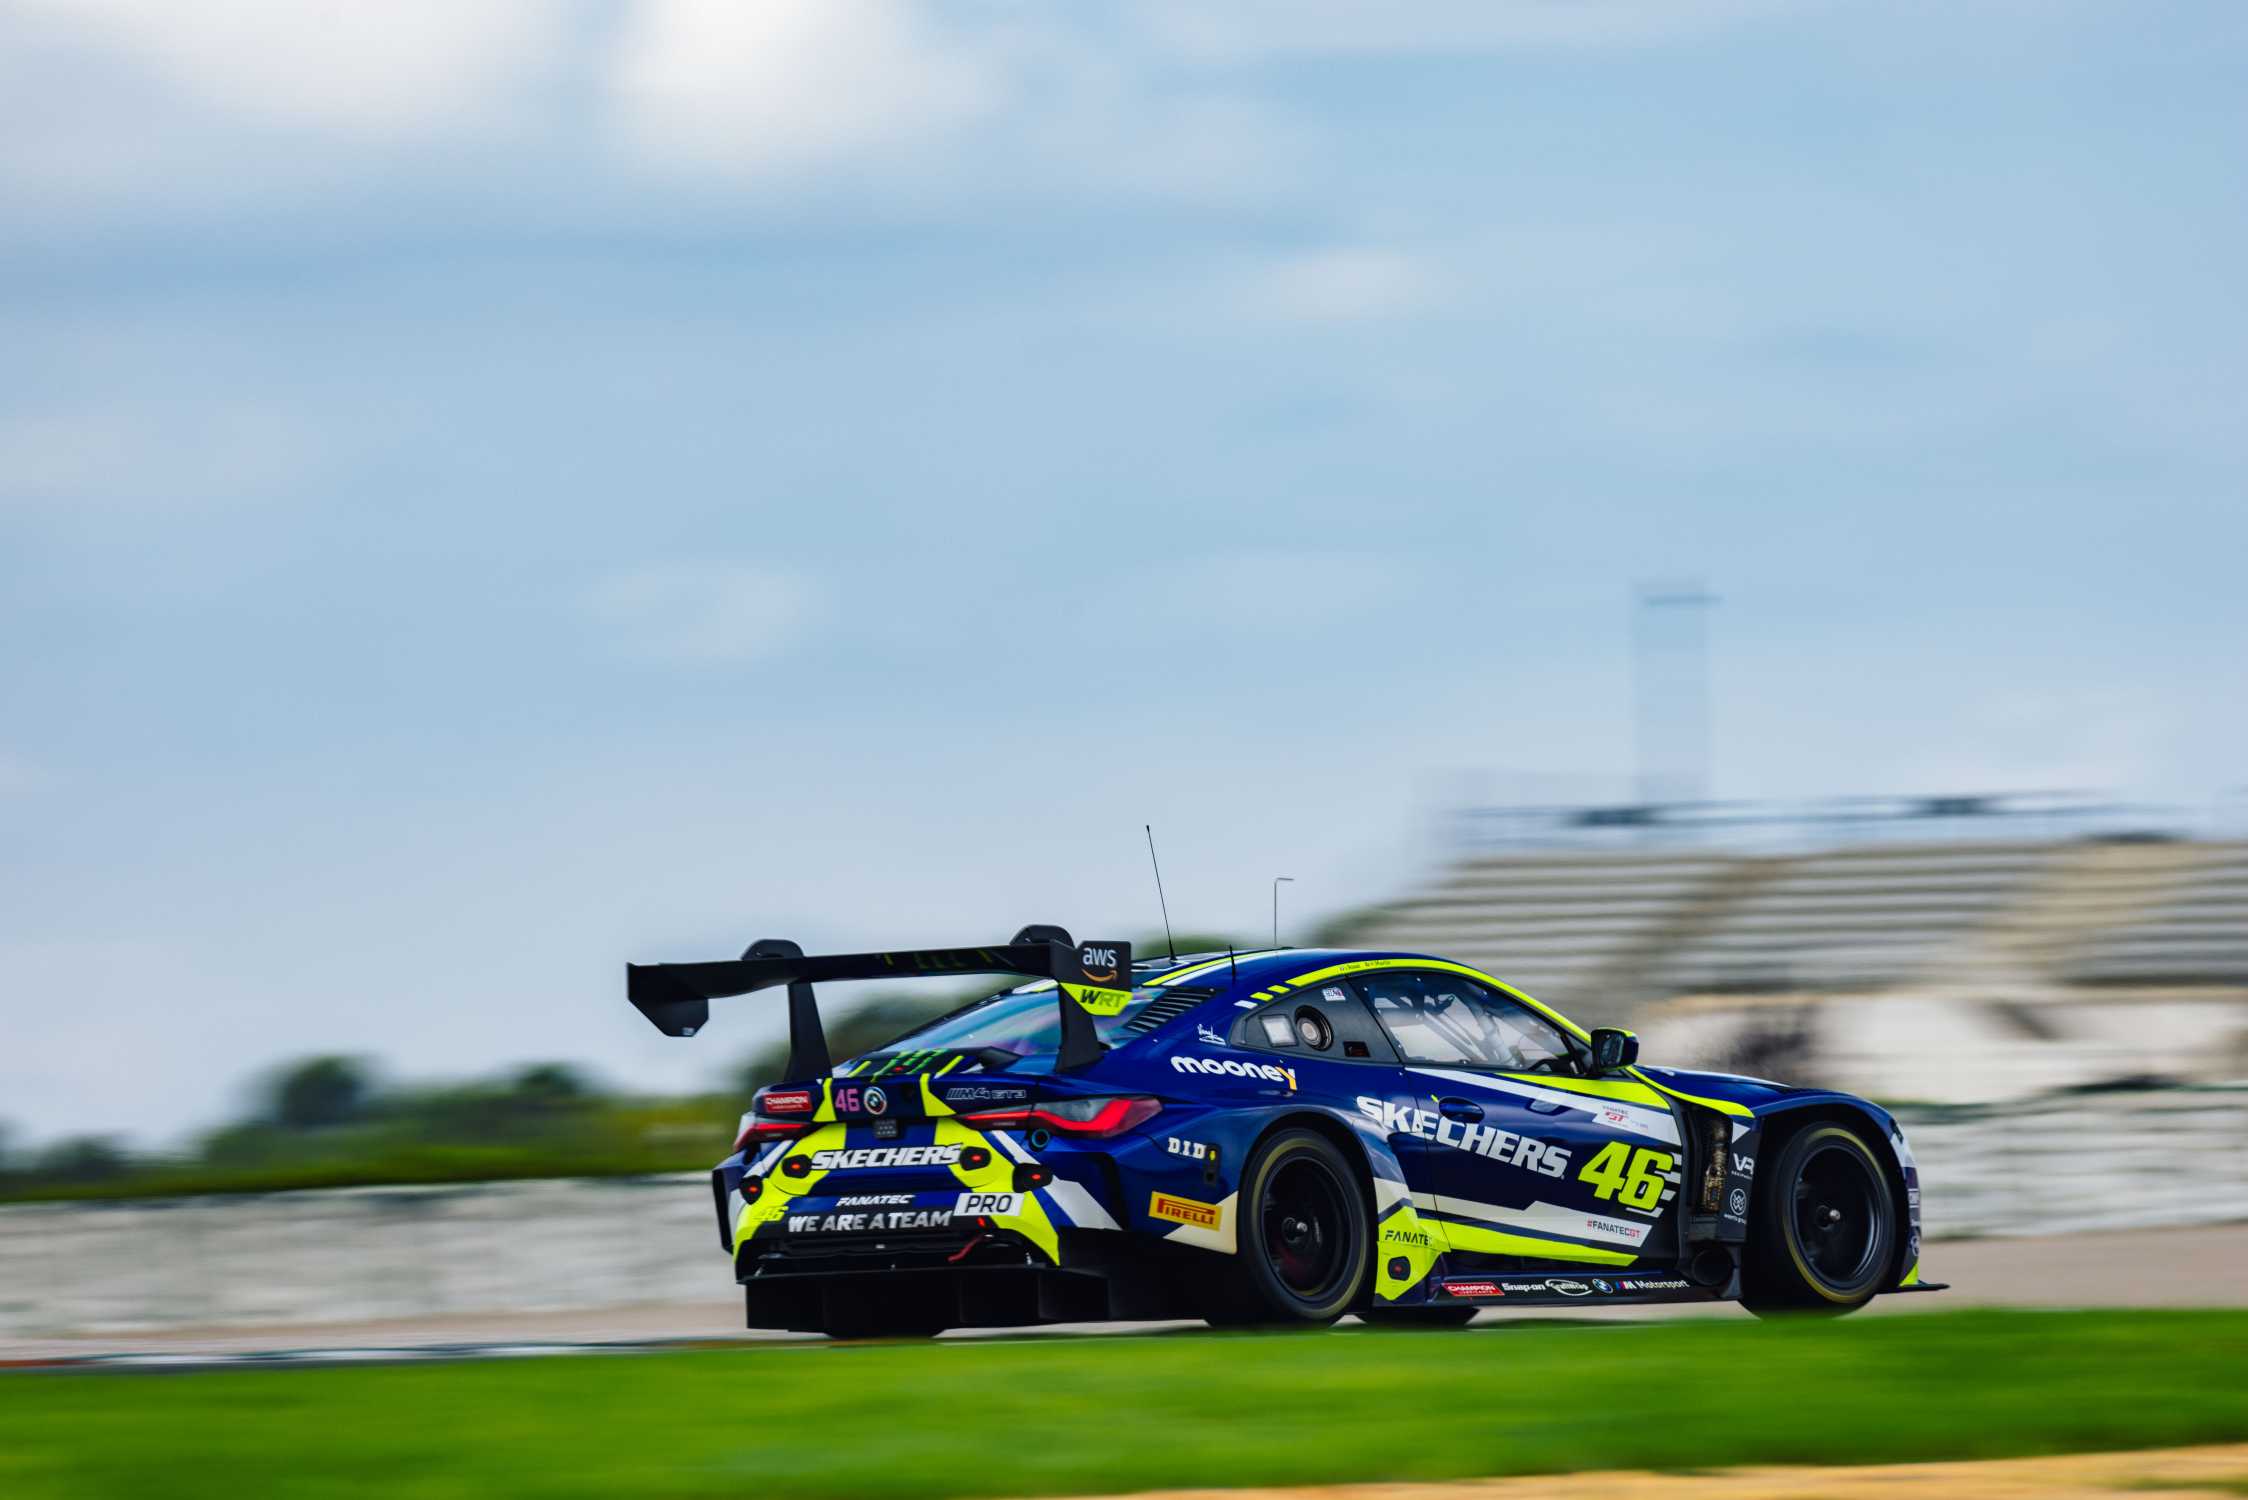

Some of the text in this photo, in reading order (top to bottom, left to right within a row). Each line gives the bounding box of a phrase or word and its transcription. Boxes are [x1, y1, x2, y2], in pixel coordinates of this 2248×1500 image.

[1082, 947, 1116, 968] aws
[1080, 989, 1126, 1008] WRT
[1170, 1056, 1297, 1091] mooney
[835, 1088, 860, 1112] 46
[1356, 1095, 1573, 1179] SKECHERS
[811, 1144, 964, 1170] SKECHERS
[1577, 1140, 1674, 1211] 46
[835, 1194, 915, 1207] FANATEC
[965, 1194, 1013, 1213] PRO
[1156, 1197, 1216, 1225] PIRELLI
[788, 1215, 820, 1232] WE
[821, 1213, 868, 1231] ARE
[1385, 1229, 1431, 1246] FANATE
[1447, 1284, 1496, 1292] CHAMPION
[1501, 1282, 1546, 1293] Snap-on
[1637, 1280, 1690, 1290] Motorsport
